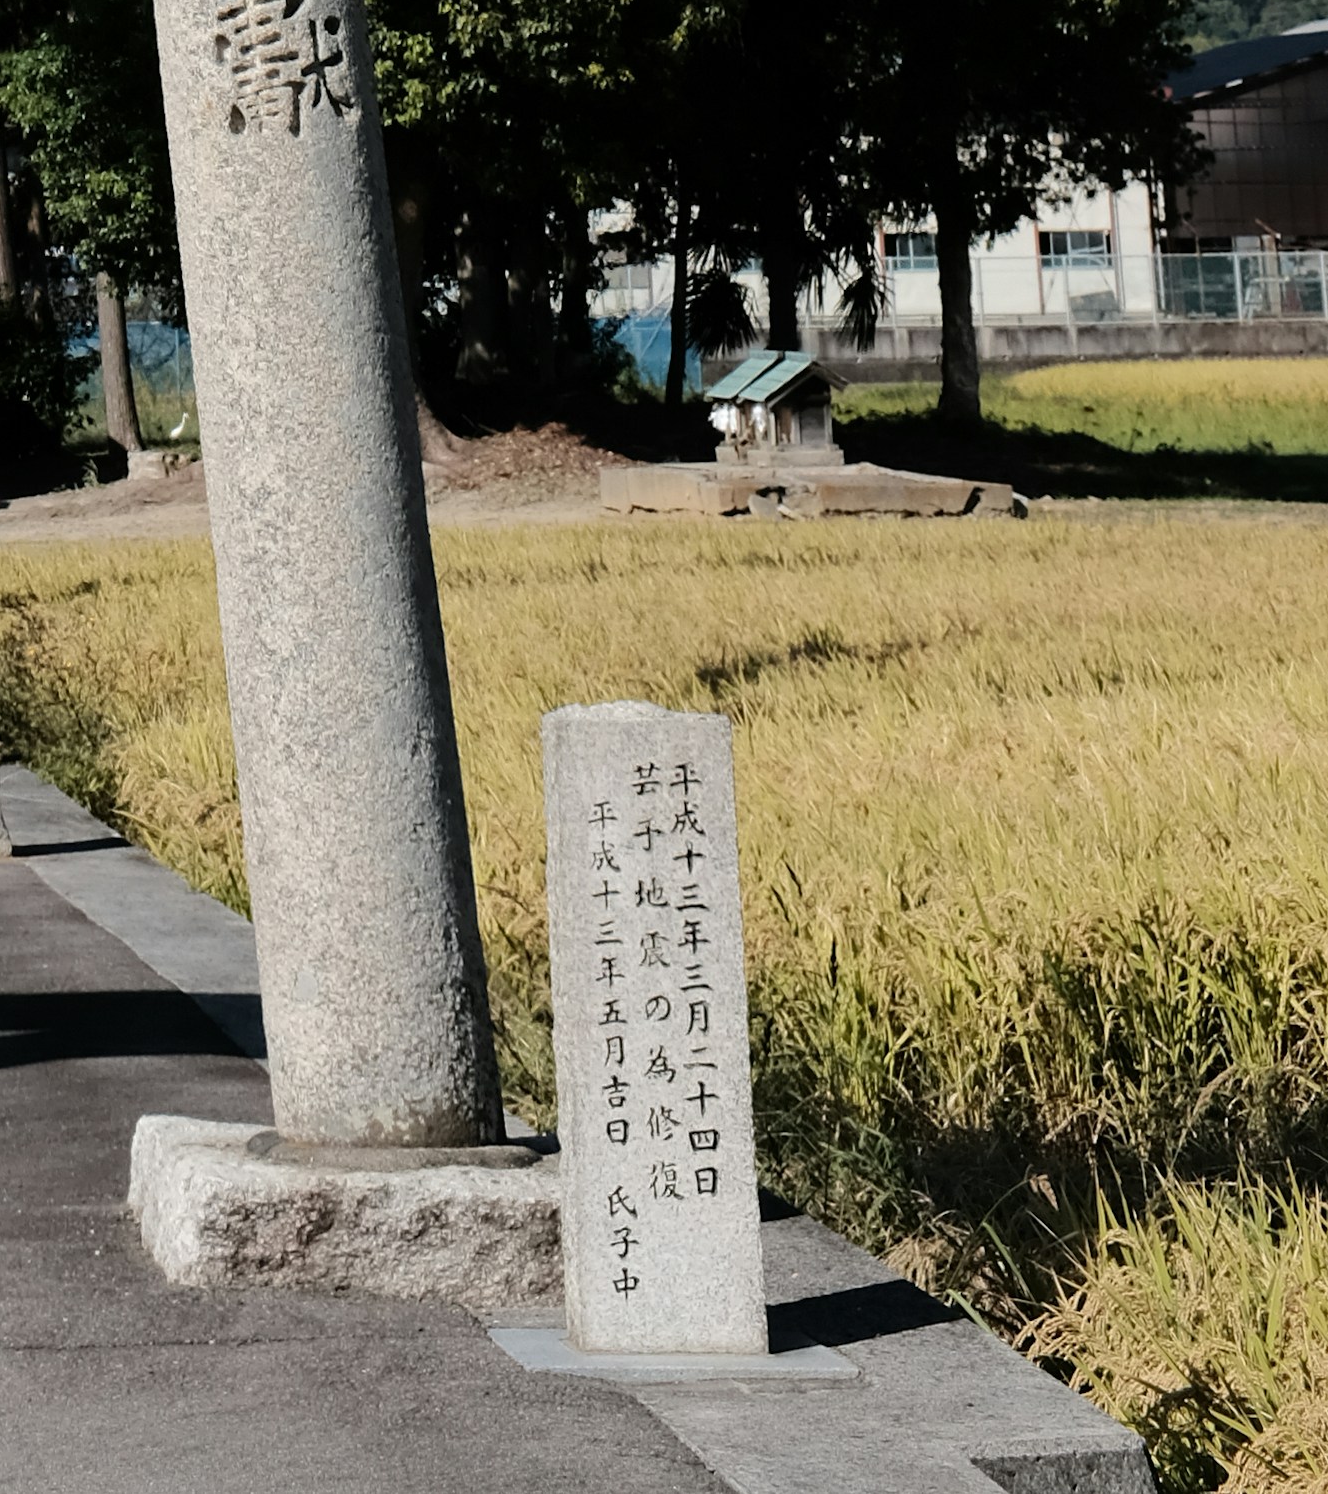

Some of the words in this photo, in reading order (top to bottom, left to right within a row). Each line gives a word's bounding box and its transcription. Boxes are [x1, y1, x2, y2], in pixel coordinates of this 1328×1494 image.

[589, 801, 630, 1146] 平成十三年五月吉日
[632, 762, 685, 1200] 芸予地震の為修復
[669, 763, 720, 1198] 平成十三年三月二十四日
[607, 1185, 640, 1300] 氏子中
